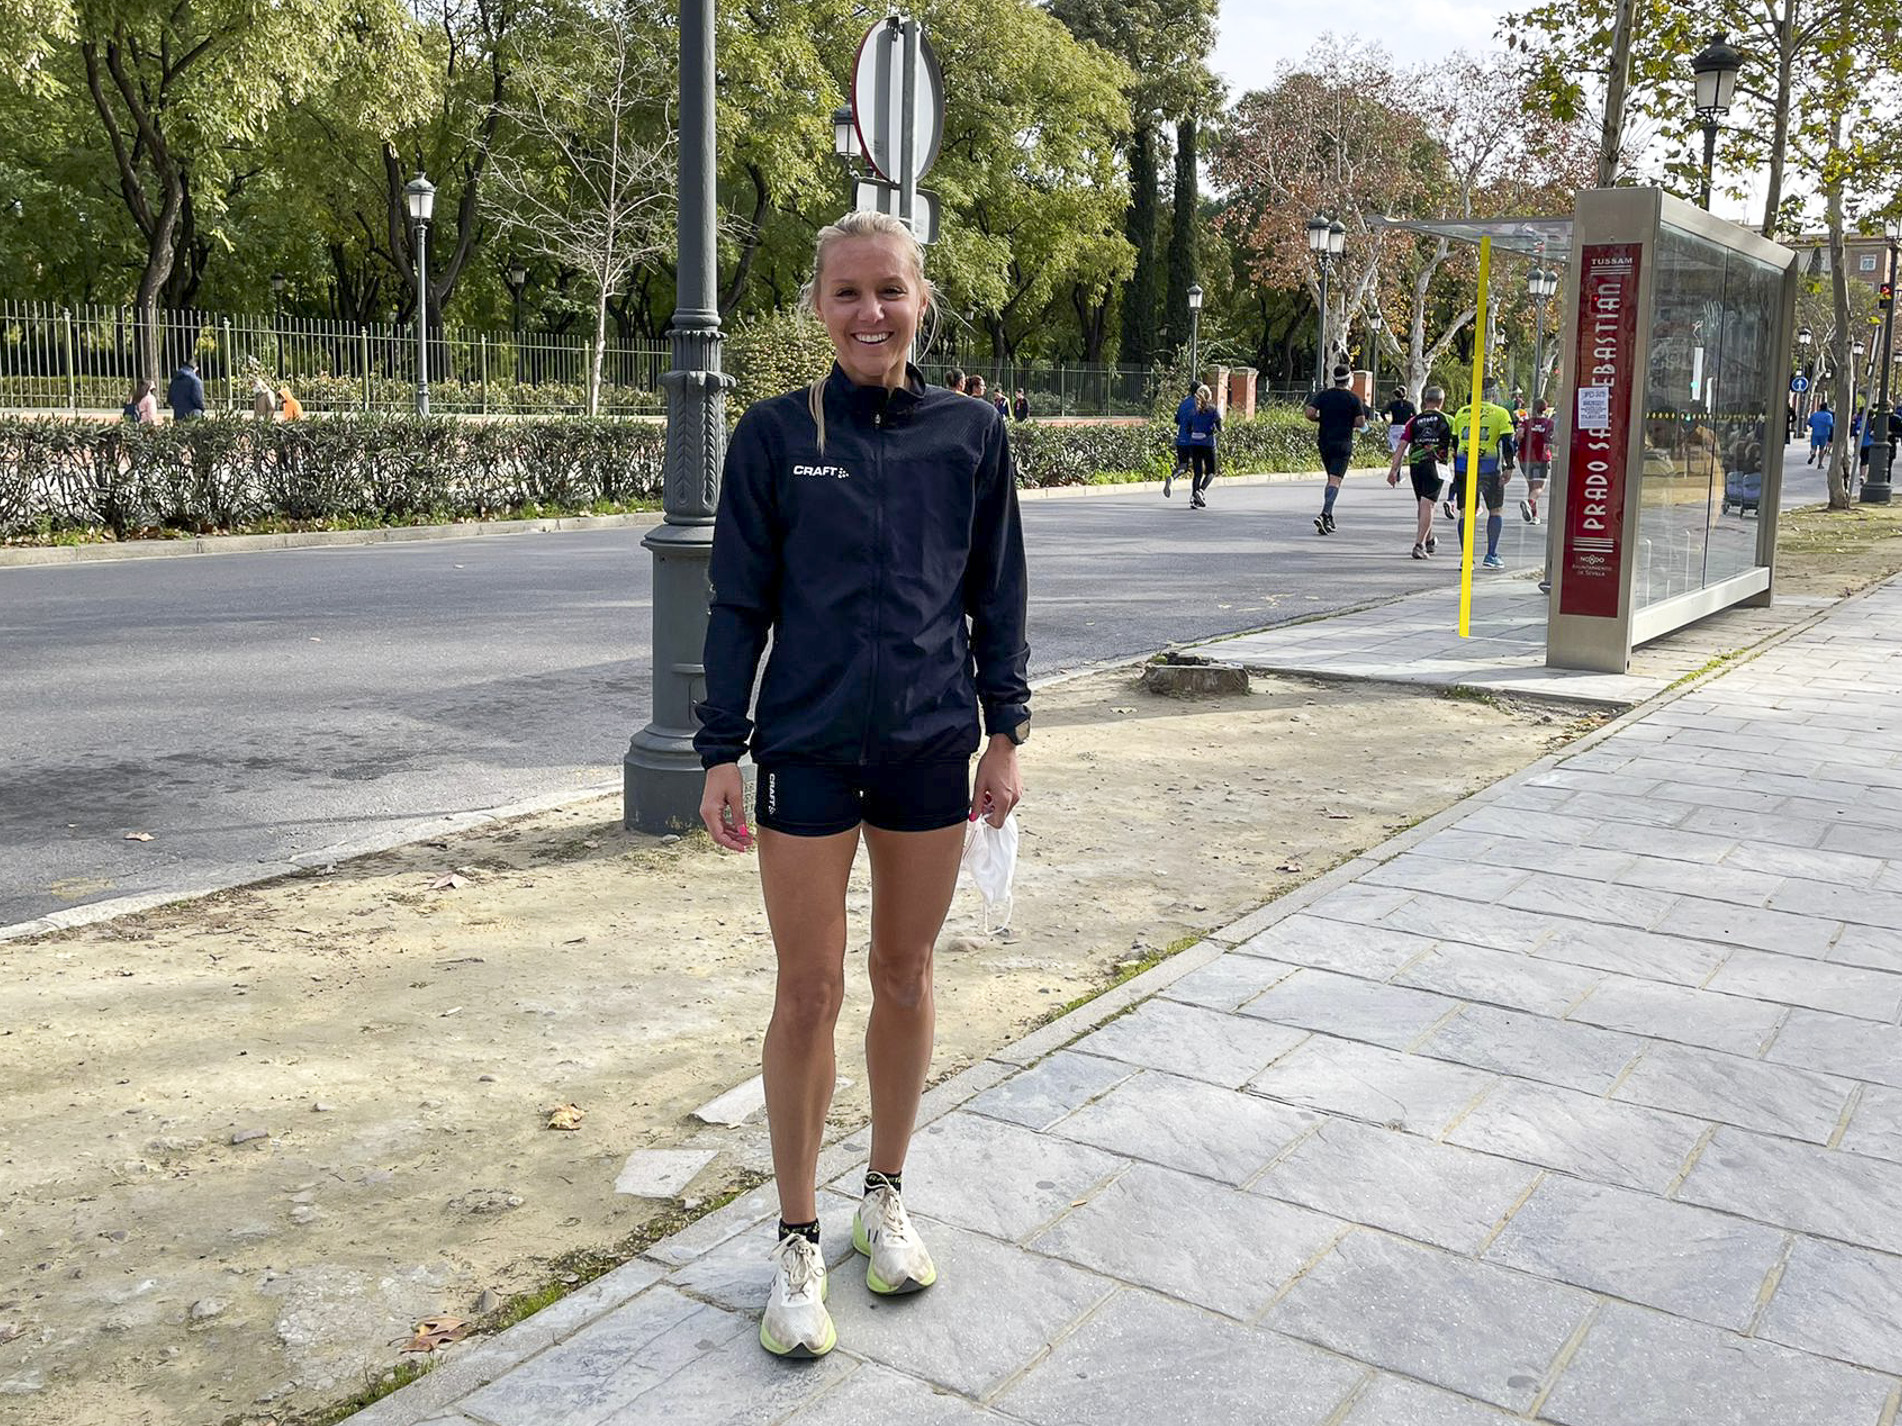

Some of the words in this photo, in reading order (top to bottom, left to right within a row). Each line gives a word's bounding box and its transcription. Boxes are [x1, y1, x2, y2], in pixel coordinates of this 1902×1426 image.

[1591, 257, 1633, 265] TUSSAM
[1591, 283, 1621, 398] EBASTIAN
[793, 465, 838, 477] CRAFT
[1583, 461, 1608, 530] PRADO
